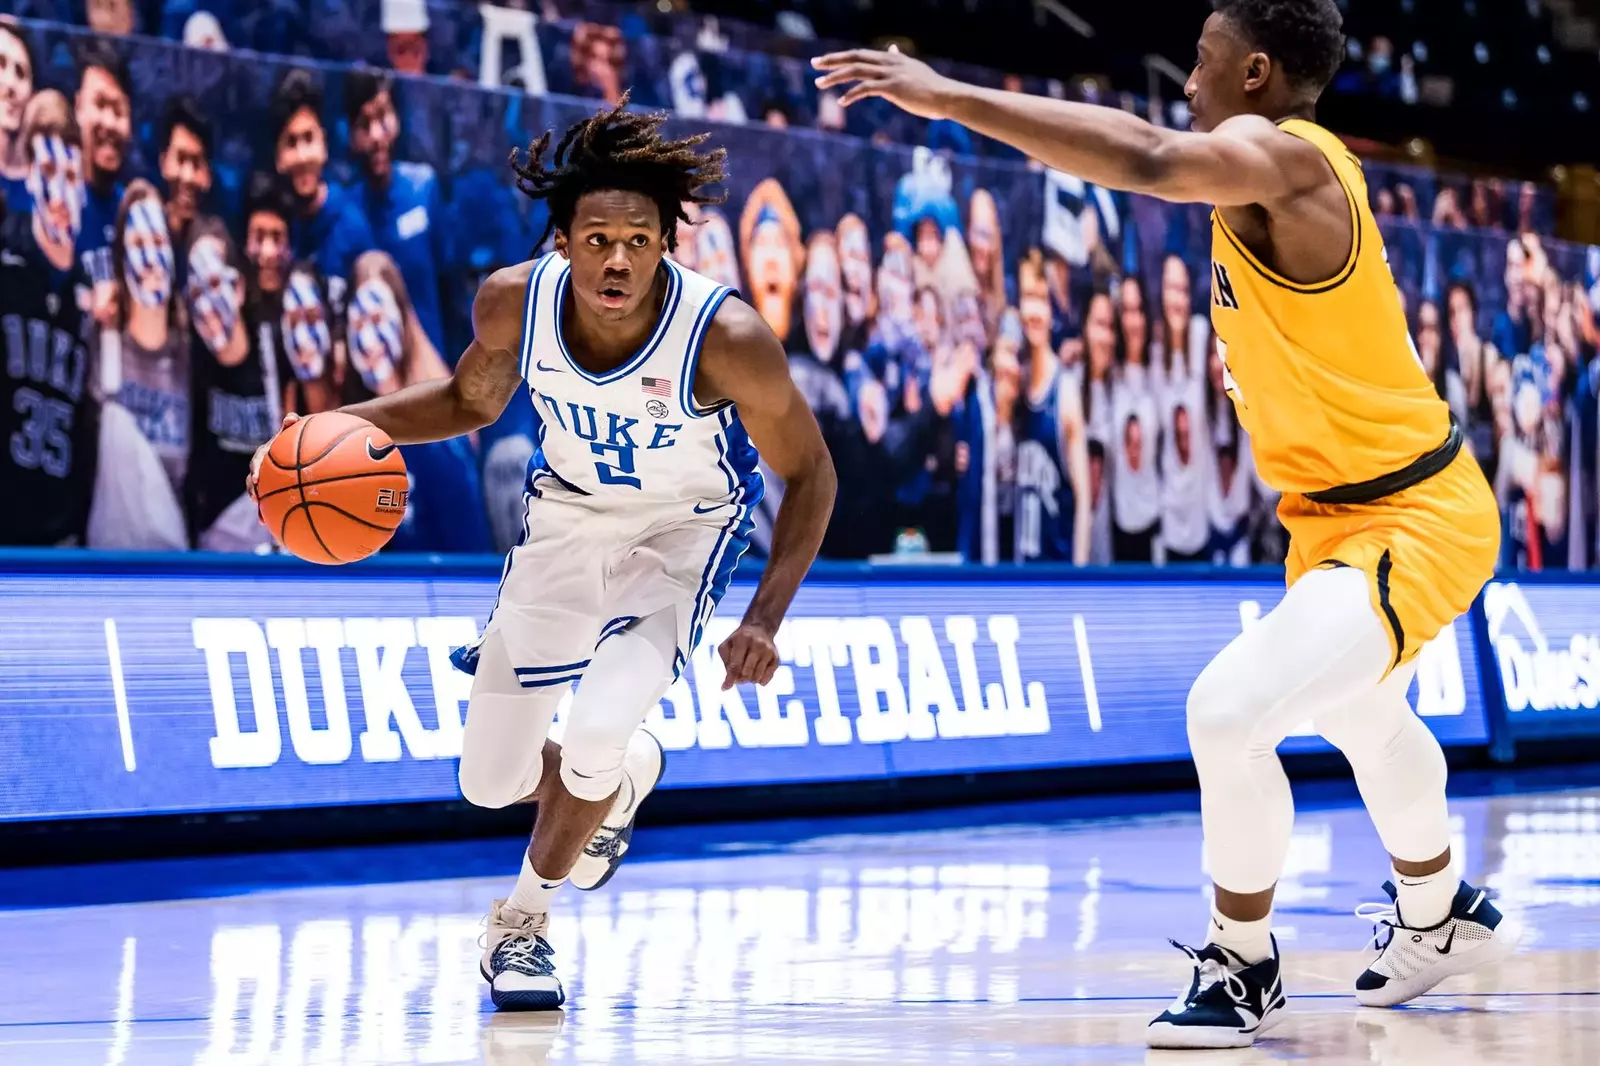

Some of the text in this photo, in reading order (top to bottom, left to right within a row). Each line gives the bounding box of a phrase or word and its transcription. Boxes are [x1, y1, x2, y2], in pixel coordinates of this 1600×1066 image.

[10, 386, 74, 479] 35
[538, 391, 683, 449] DUKE
[590, 442, 641, 490] 2
[192, 617, 480, 768] DUKE
